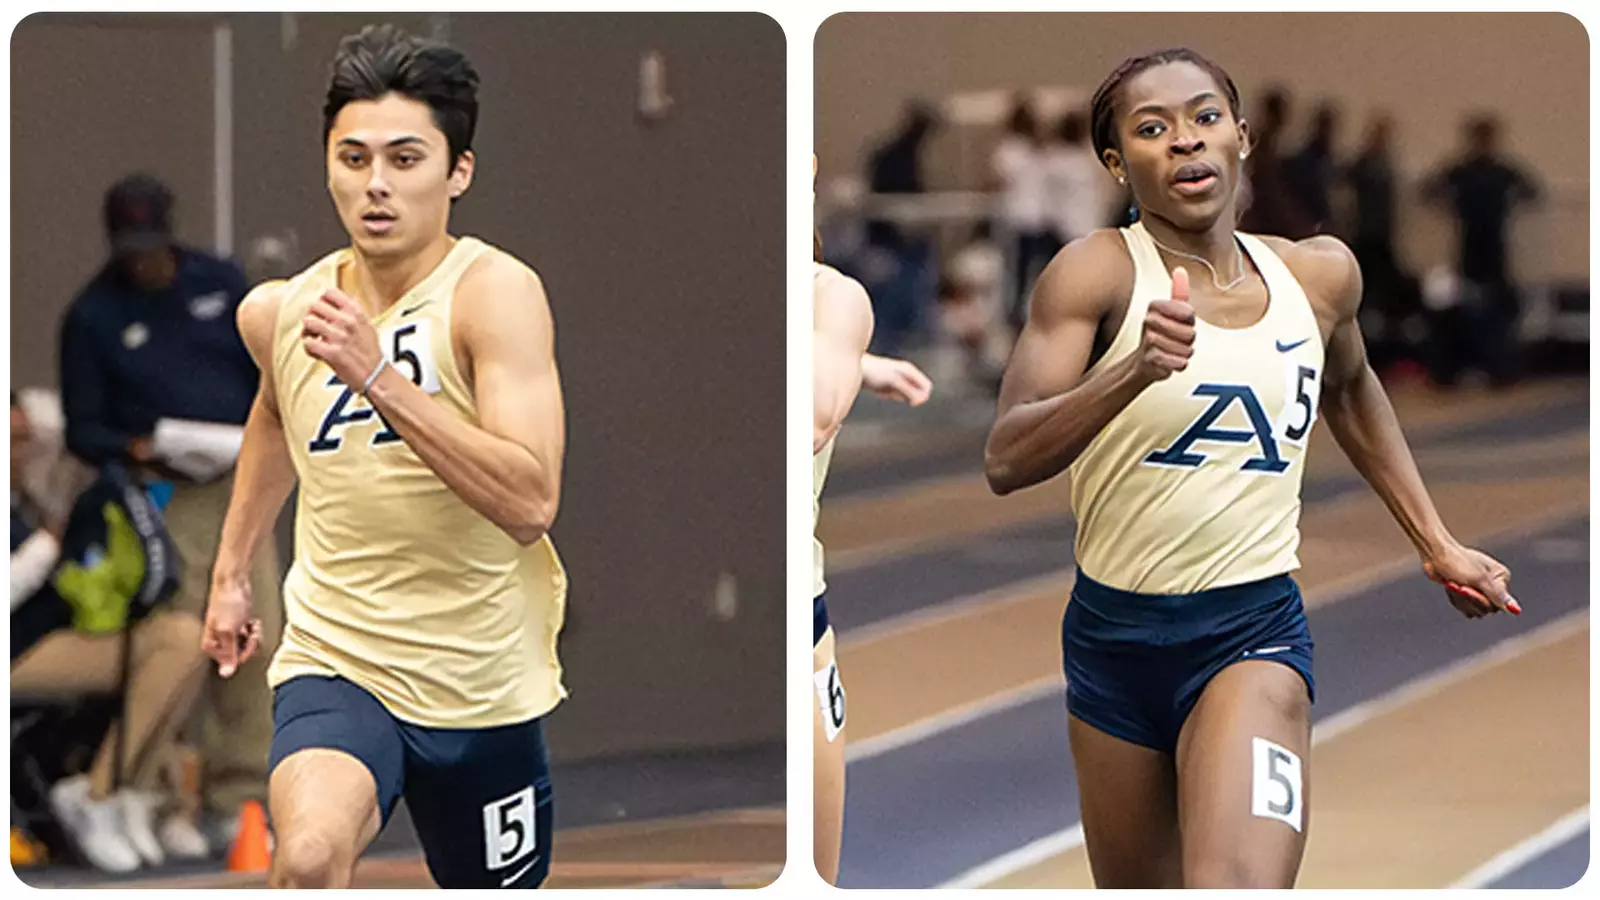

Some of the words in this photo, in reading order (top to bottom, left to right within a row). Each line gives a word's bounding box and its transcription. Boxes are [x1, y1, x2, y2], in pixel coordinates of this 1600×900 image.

[392, 325, 422, 387] 5
[309, 376, 404, 453] A
[1144, 383, 1290, 473] A
[1284, 365, 1316, 441] 5
[828, 664, 845, 728] 6
[1268, 747, 1294, 815] 5
[499, 796, 525, 862] 5
